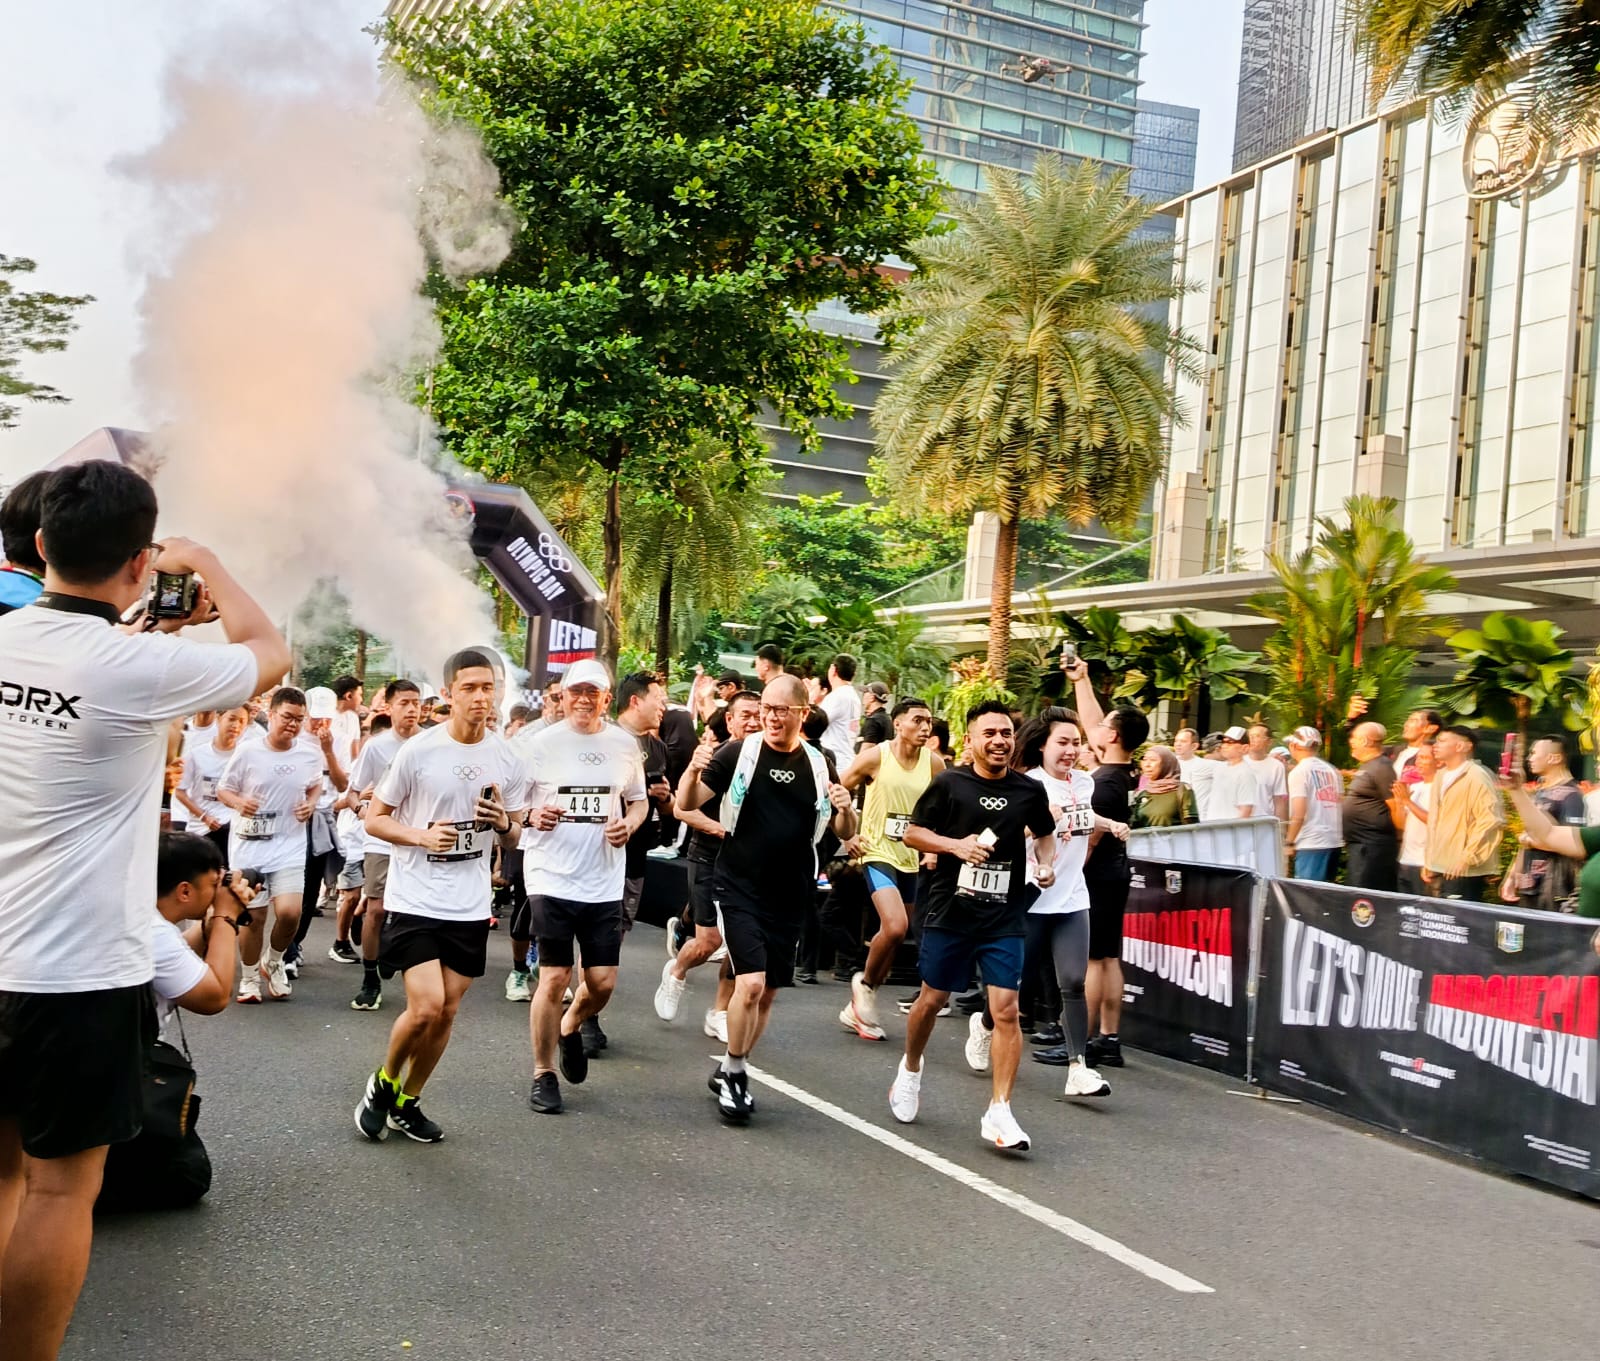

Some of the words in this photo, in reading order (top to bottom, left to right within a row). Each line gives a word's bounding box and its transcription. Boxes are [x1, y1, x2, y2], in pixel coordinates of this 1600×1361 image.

[506, 536, 551, 583] OLYMPIC
[537, 575, 567, 601] DAY
[549, 619, 582, 651] LET'S
[8, 712, 68, 730] TOKEN
[570, 796, 601, 813] 443
[1067, 812, 1089, 828] 245
[972, 870, 999, 890] 101
[1122, 907, 1233, 1007] INDONESIA
[1280, 917, 1366, 1028] LET'S
[1359, 950, 1424, 1031] MOVE
[1424, 974, 1599, 1106] INDONESIA
